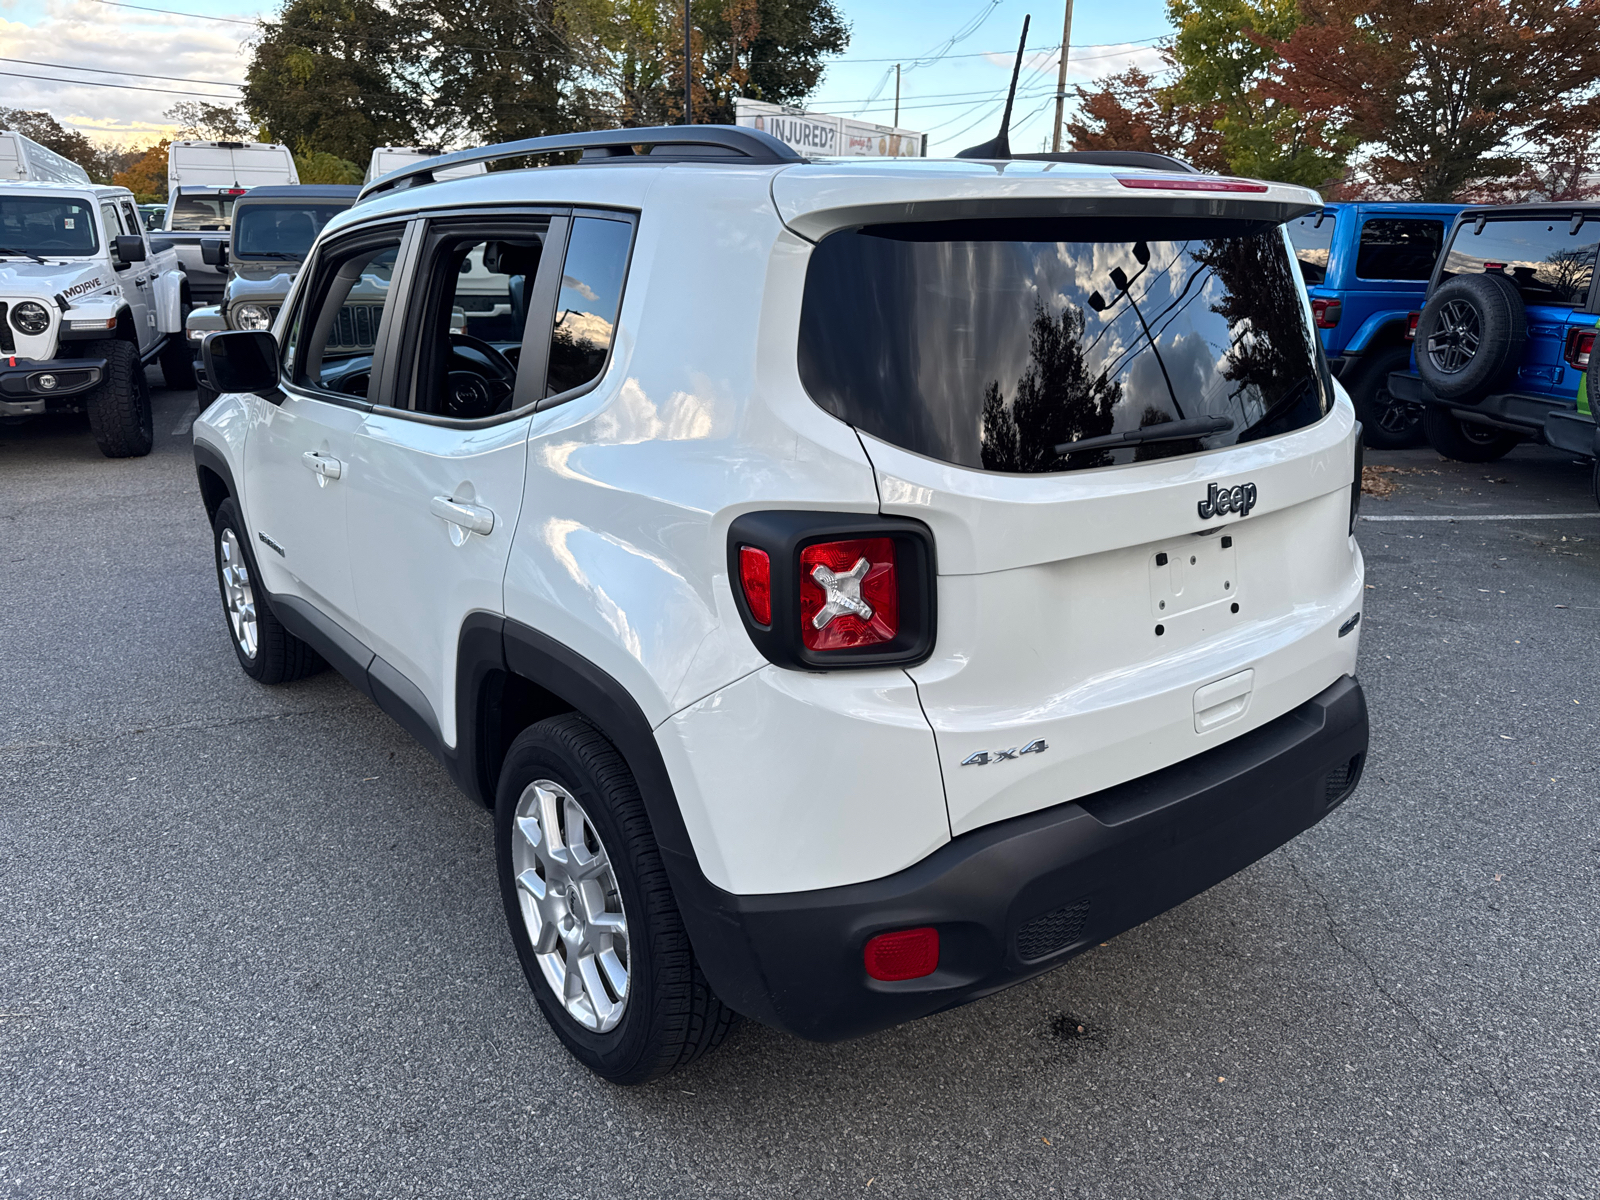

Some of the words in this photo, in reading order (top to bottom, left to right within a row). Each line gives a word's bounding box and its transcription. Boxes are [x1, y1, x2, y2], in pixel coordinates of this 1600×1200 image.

[770, 117, 835, 150] INJURED?
[62, 277, 102, 299] MOJAVE
[1197, 482, 1257, 520] Jeep
[961, 737, 1049, 766] 4x4
